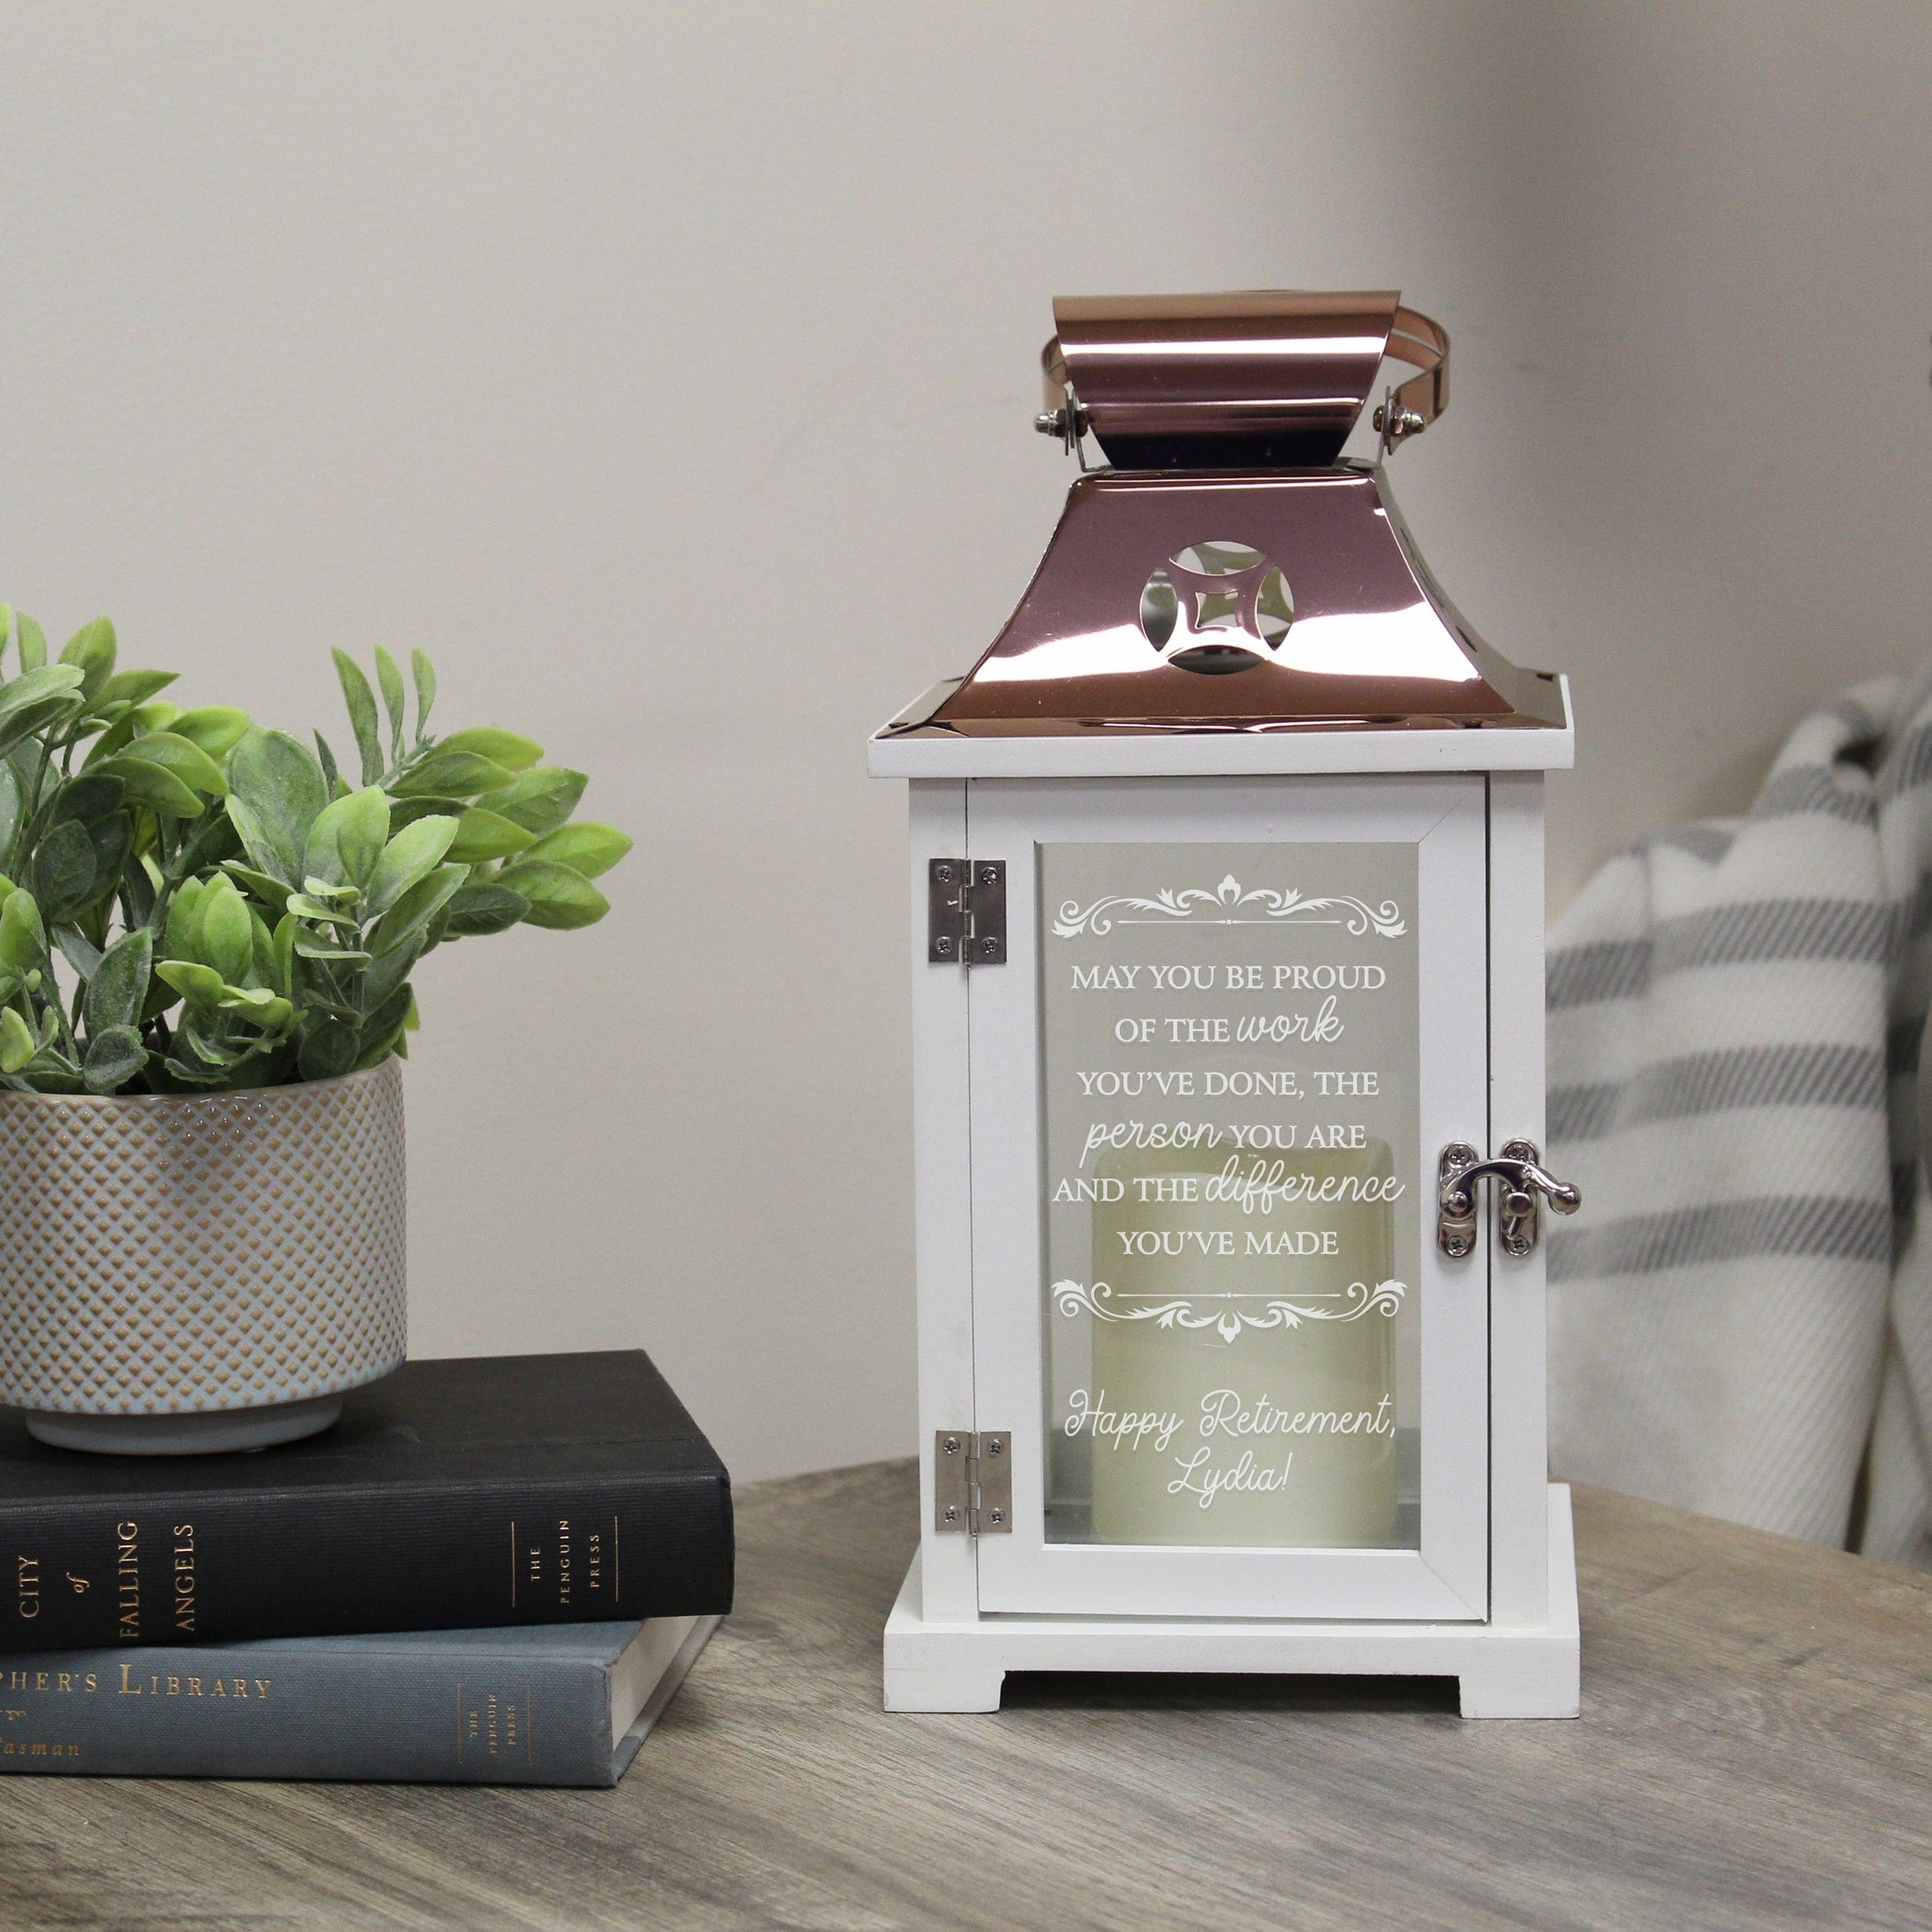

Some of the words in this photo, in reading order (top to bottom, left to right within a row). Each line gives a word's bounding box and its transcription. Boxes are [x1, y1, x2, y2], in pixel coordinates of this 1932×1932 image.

[1070, 965, 1141, 989] MAY
[1147, 965, 1216, 989] YOU
[1225, 965, 1264, 989] BE
[1272, 965, 1386, 989] PROUD
[1114, 1018, 1156, 1043] OF
[1164, 1018, 1231, 1043] THE
[1236, 995, 1344, 1043] work
[1076, 1072, 1195, 1096] YOU’VE
[1203, 1072, 1305, 1100] DONE,
[1313, 1072, 1379, 1096] THE
[1079, 1121, 1223, 1168] person
[1229, 1124, 1298, 1149] YOU
[1305, 1124, 1366, 1149] ARE
[1052, 1178, 1125, 1202] AND
[1133, 1178, 1199, 1202] THE
[1205, 1154, 1406, 1214] difference
[1117, 1231, 1235, 1256] YOU’VE
[1244, 1231, 1340, 1256] MADE
[1064, 1389, 1183, 1452] Happy
[1199, 1388, 1396, 1438] Retirement,
[1167, 1446, 1293, 1509] Lydia!
[18, 1555, 40, 1618] CITY
[65, 1572, 90, 1593] of
[117, 1521, 139, 1638] FALLING
[174, 1524, 195, 1632] ANGELS
[530, 1547, 541, 1581] THE
[559, 1520, 570, 1604] PENGUIN
[590, 1535, 600, 1589] PRESS
[0, 1736, 80, 1755] asman
